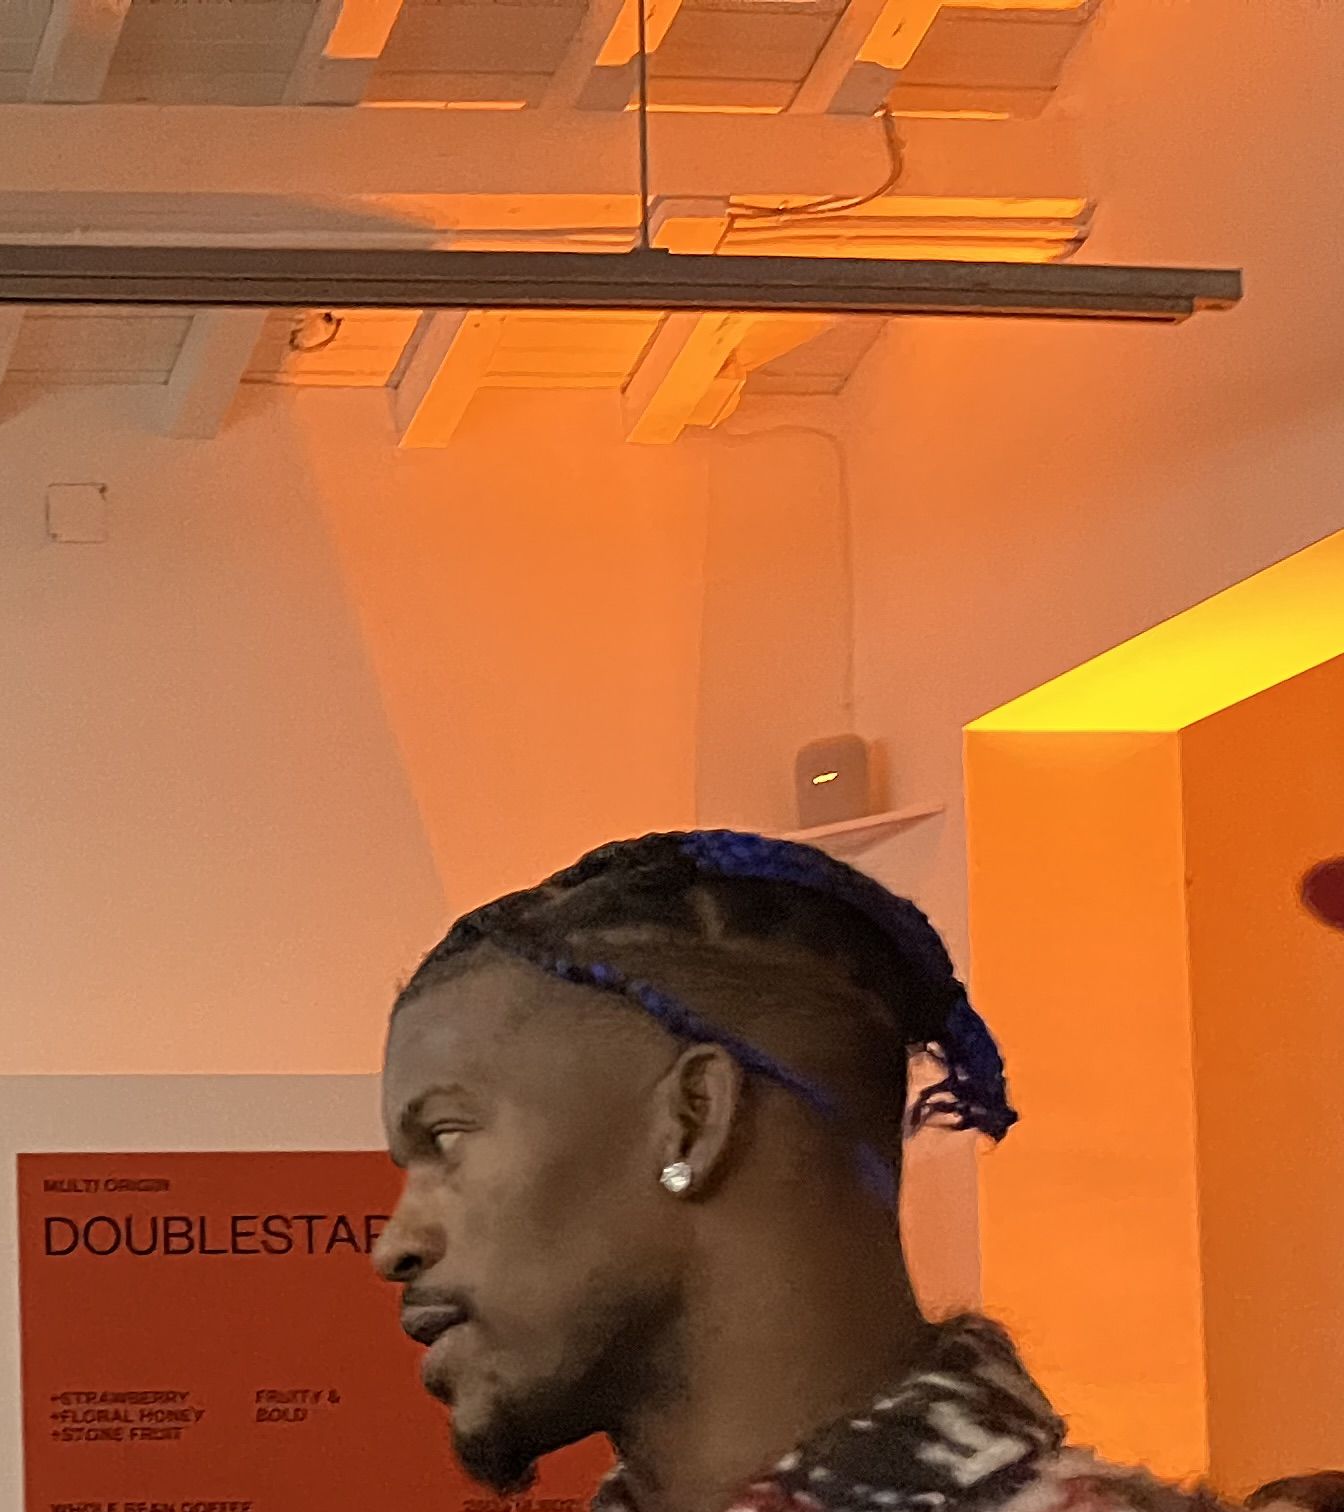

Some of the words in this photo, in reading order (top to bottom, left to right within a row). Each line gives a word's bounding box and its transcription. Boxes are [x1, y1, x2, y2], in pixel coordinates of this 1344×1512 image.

[44, 1178, 100, 1192] MULTI
[139, 1408, 205, 1423] HONEY
[255, 1408, 308, 1422] BOLD
